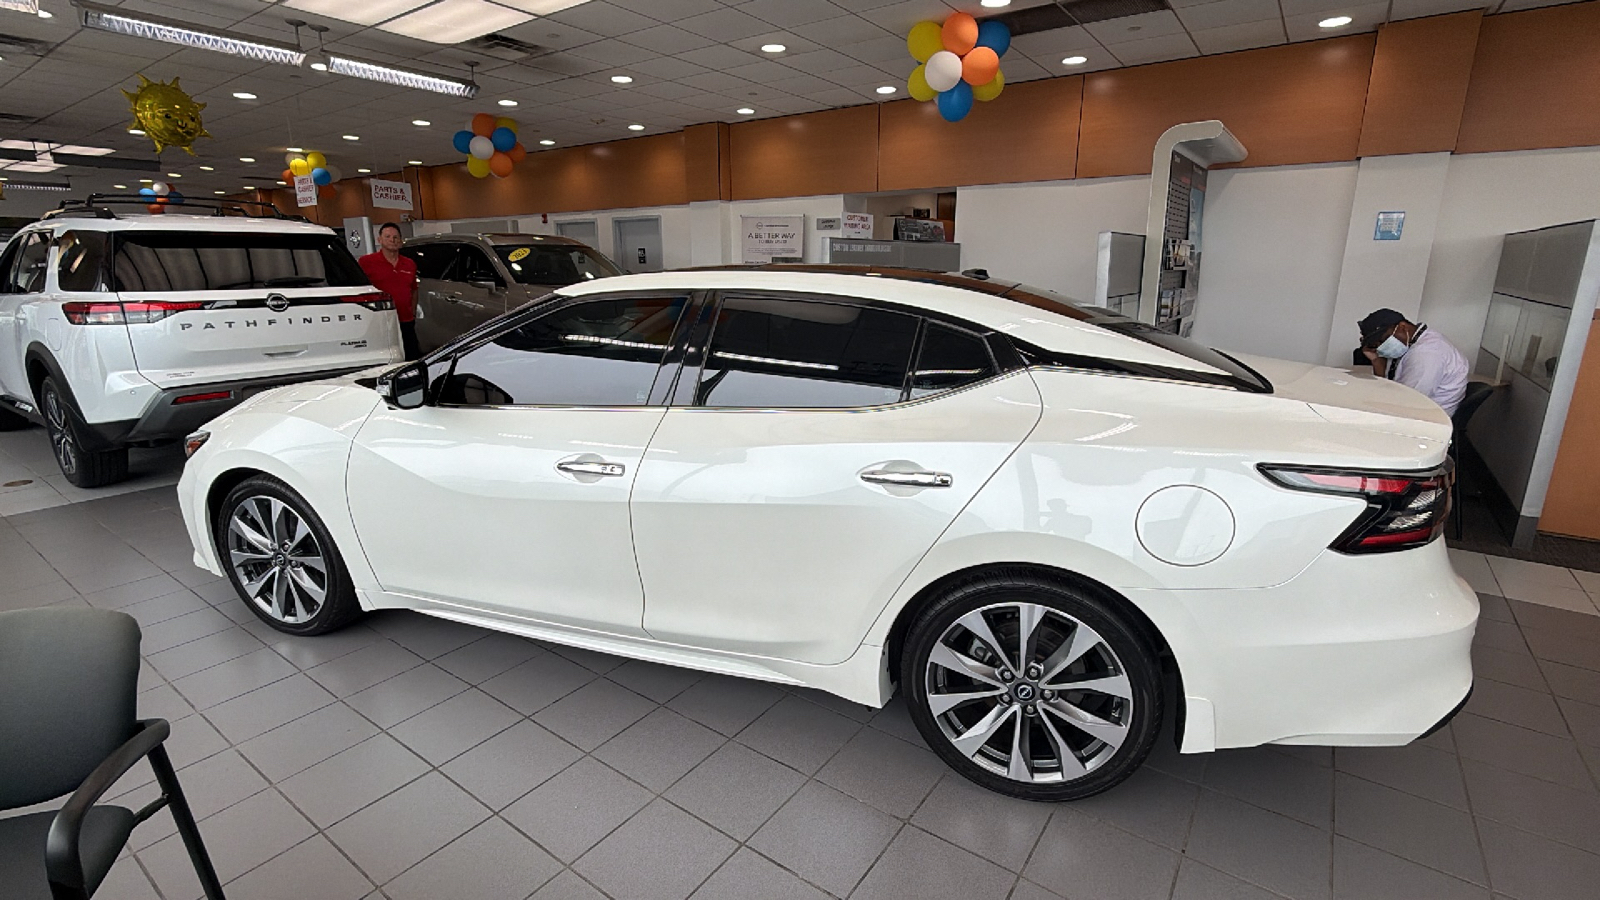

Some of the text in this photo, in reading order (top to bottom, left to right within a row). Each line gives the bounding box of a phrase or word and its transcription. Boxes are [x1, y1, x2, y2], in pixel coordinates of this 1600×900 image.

[374, 185, 398, 194] PARTS
[374, 192, 407, 202] CASHIER
[180, 314, 363, 331] PATHFINDER
